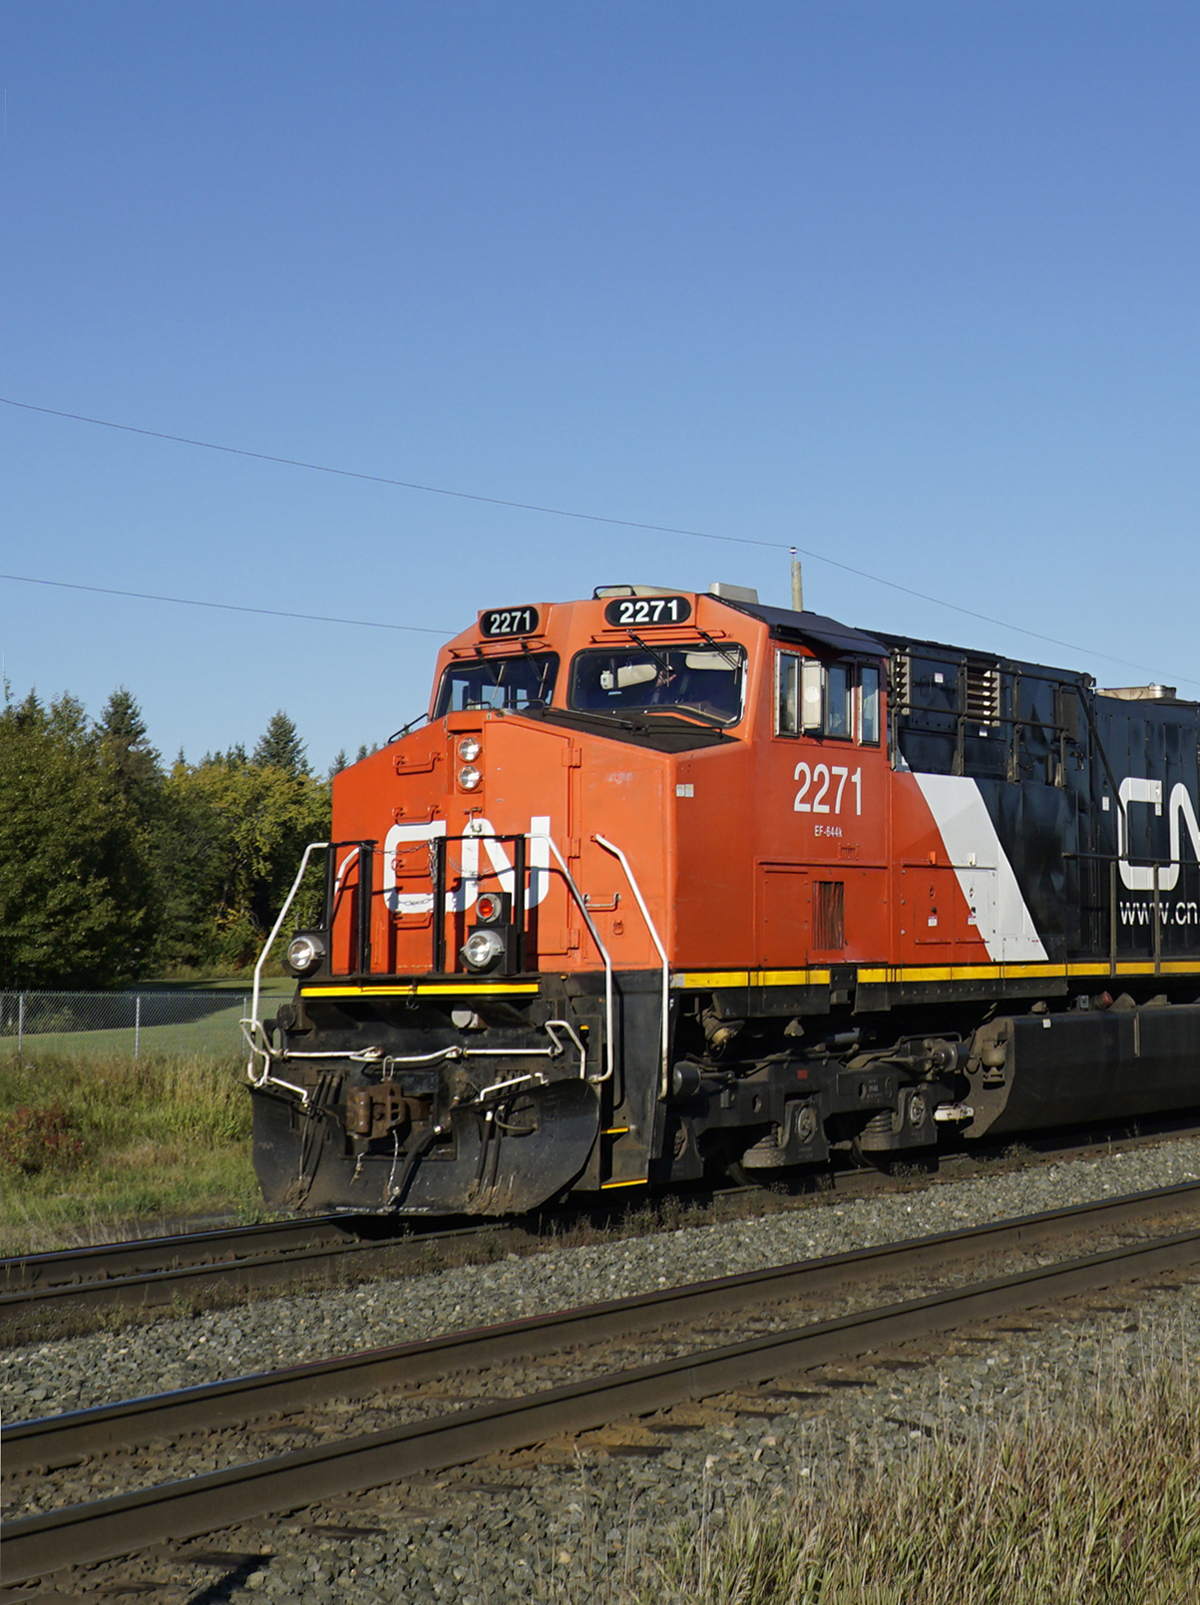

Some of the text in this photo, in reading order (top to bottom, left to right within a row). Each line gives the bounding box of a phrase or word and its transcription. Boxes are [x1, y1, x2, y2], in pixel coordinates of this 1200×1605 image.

[490, 610, 530, 634] 2271
[619, 600, 678, 624] 2271
[793, 761, 862, 816] 2271
[383, 816, 550, 914] CN
